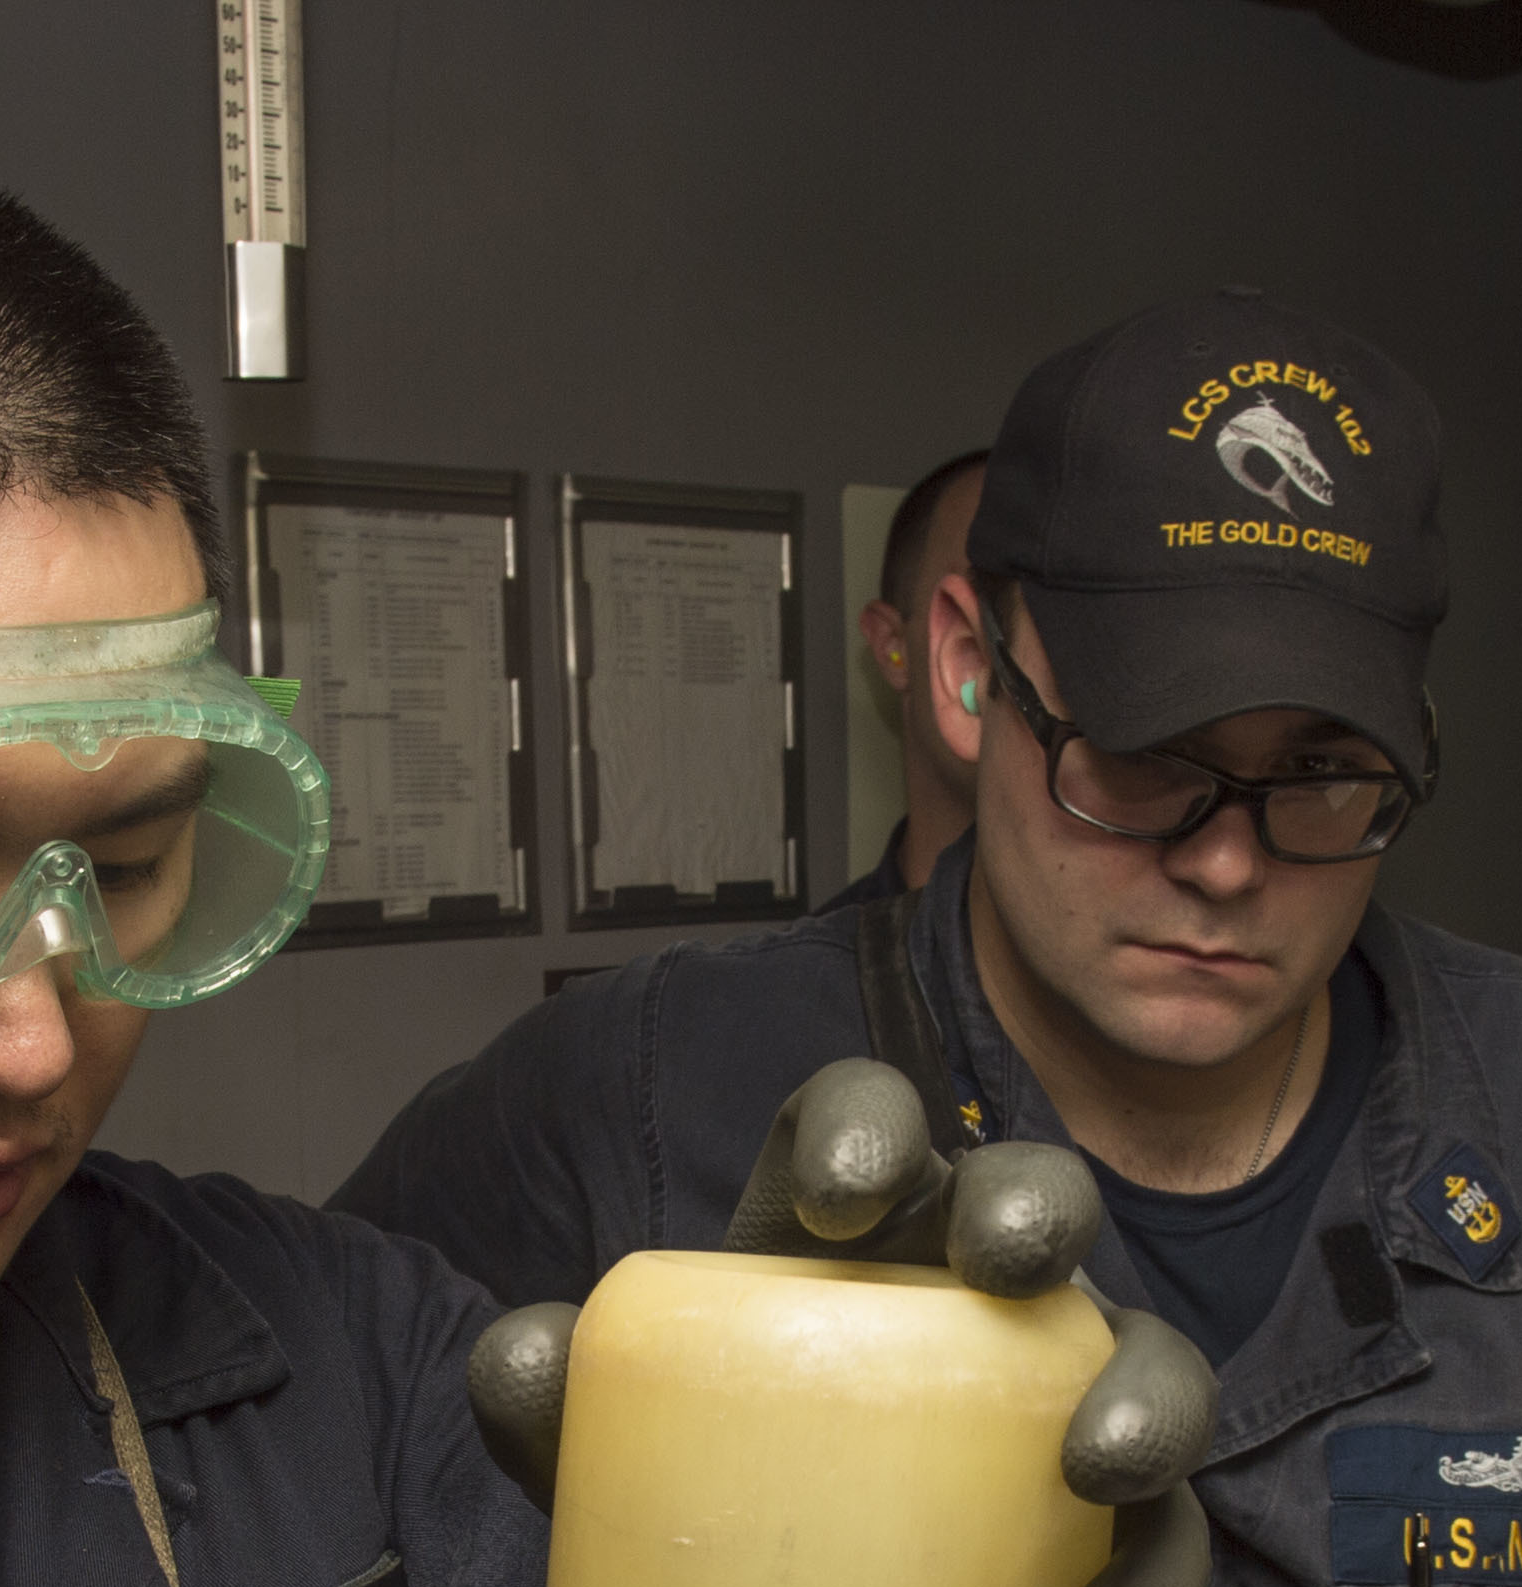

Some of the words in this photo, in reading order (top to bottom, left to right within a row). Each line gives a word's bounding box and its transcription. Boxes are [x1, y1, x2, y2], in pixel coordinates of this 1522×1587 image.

[1167, 379, 1231, 441] LCS
[1229, 360, 1337, 403] CREW
[1334, 404, 1372, 457] 102
[1160, 521, 1215, 548] THE
[1219, 520, 1299, 547] GOLD
[1301, 528, 1373, 567] CREW
[1446, 1180, 1489, 1226] USN
